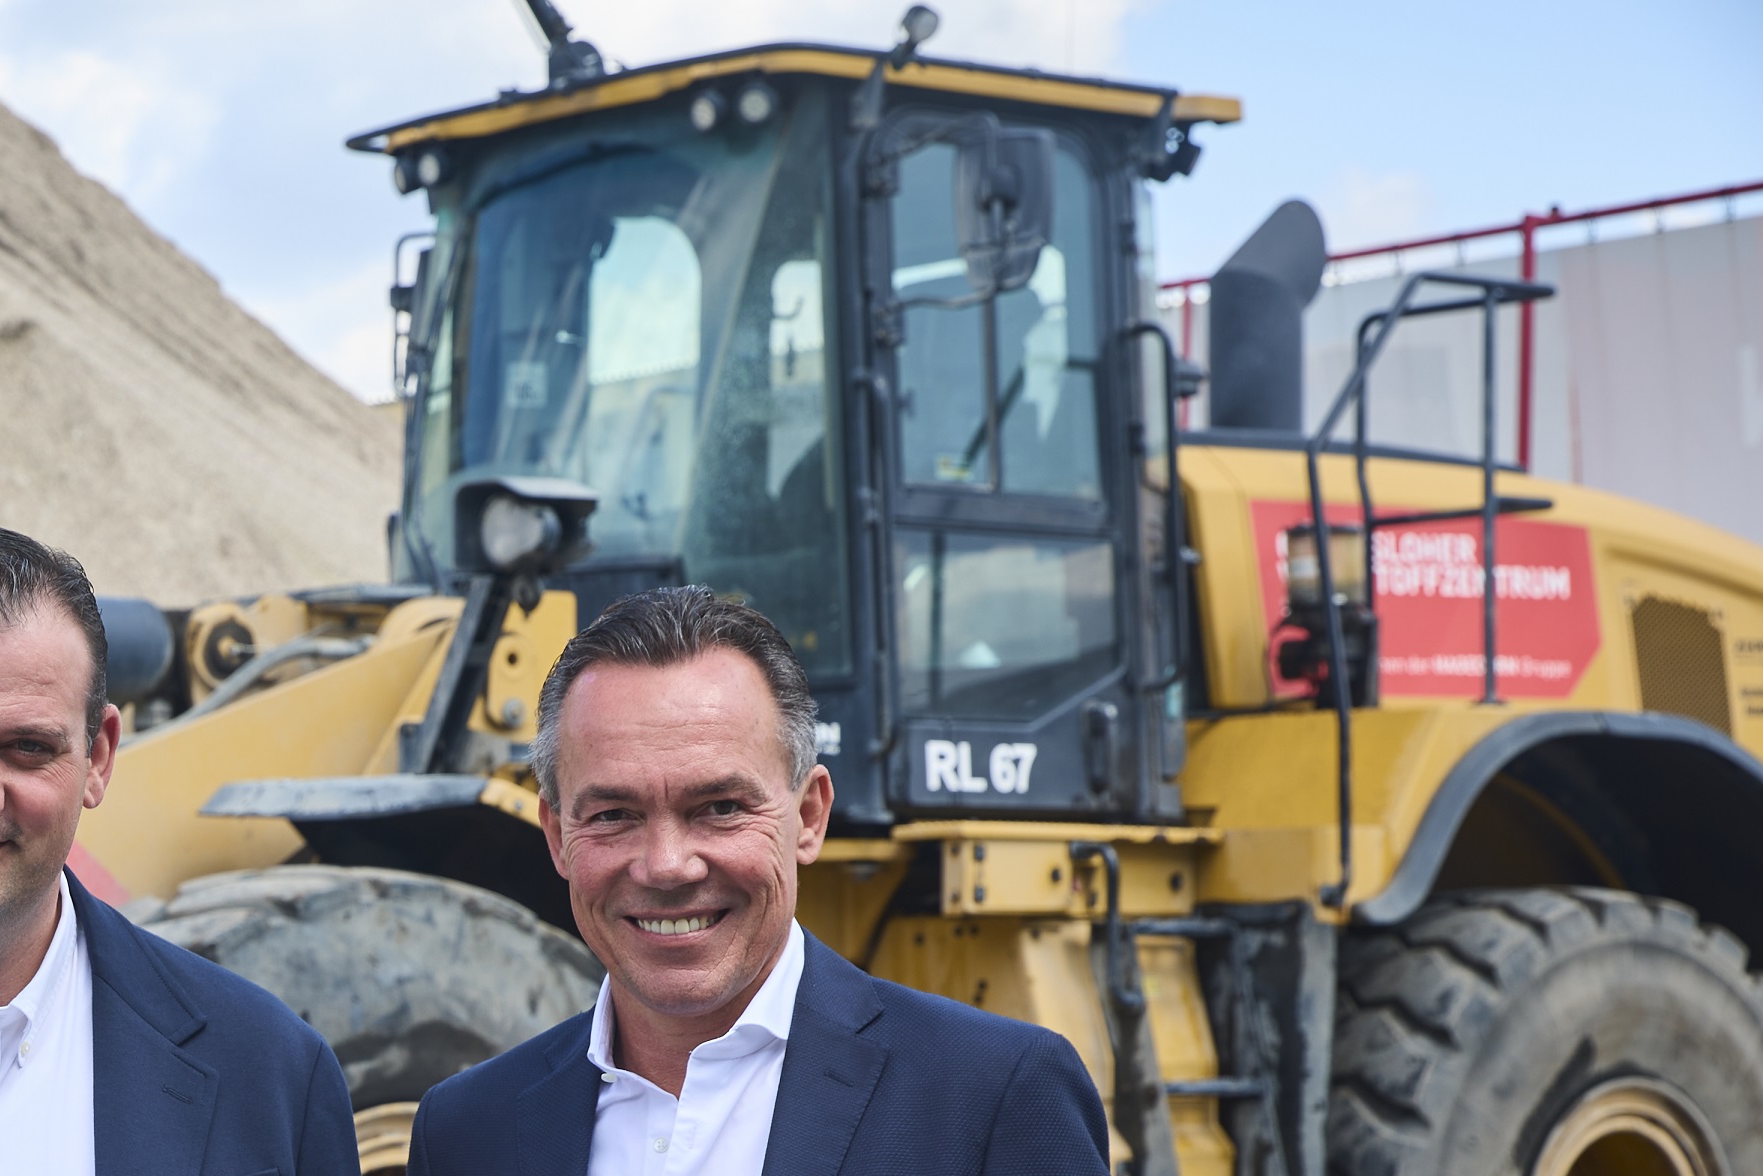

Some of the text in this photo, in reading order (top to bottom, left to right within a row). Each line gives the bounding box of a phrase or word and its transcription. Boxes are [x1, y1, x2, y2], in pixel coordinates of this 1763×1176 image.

[1274, 560, 1571, 600] TOFFZENTRUM
[924, 739, 1037, 794] RL 67
